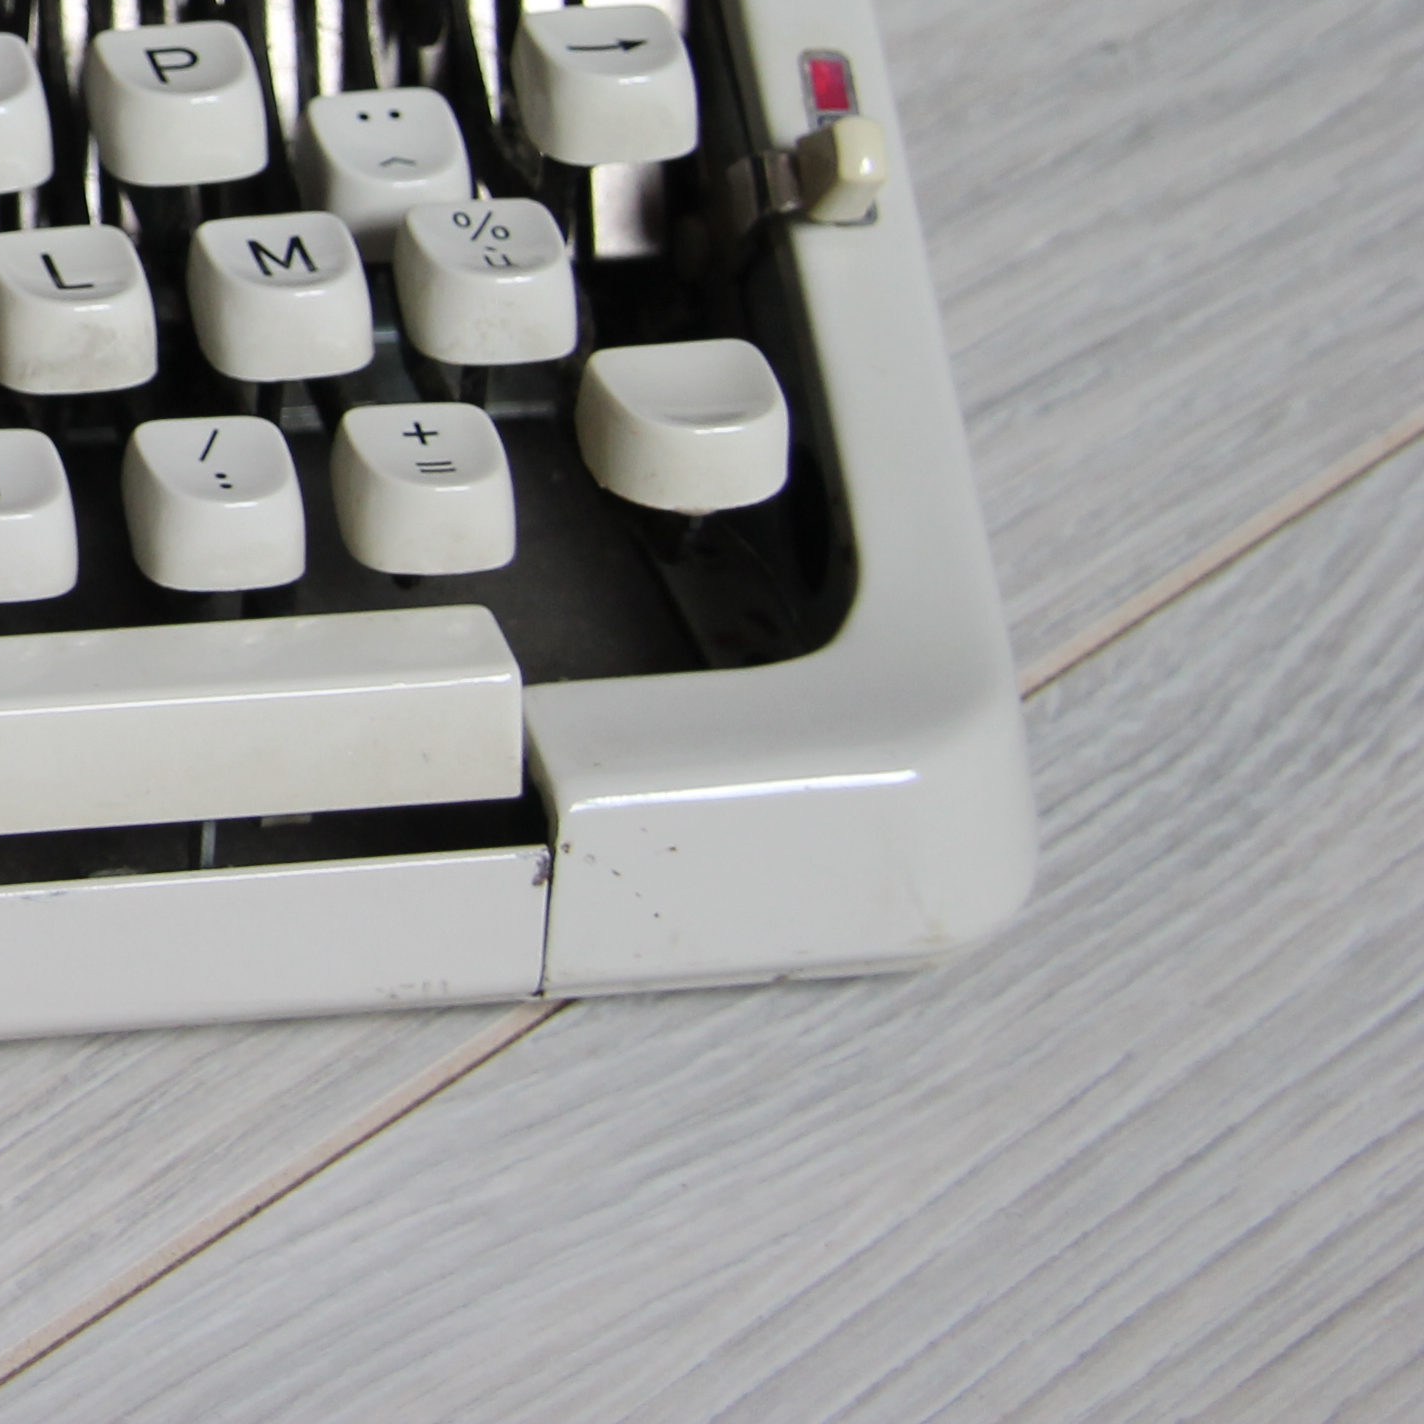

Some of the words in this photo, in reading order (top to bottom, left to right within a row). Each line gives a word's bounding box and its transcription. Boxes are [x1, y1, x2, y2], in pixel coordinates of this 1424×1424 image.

[144, 46, 199, 84] P
[453, 209, 510, 242] %
[41, 252, 94, 291] L
[247, 235, 319, 277] M
